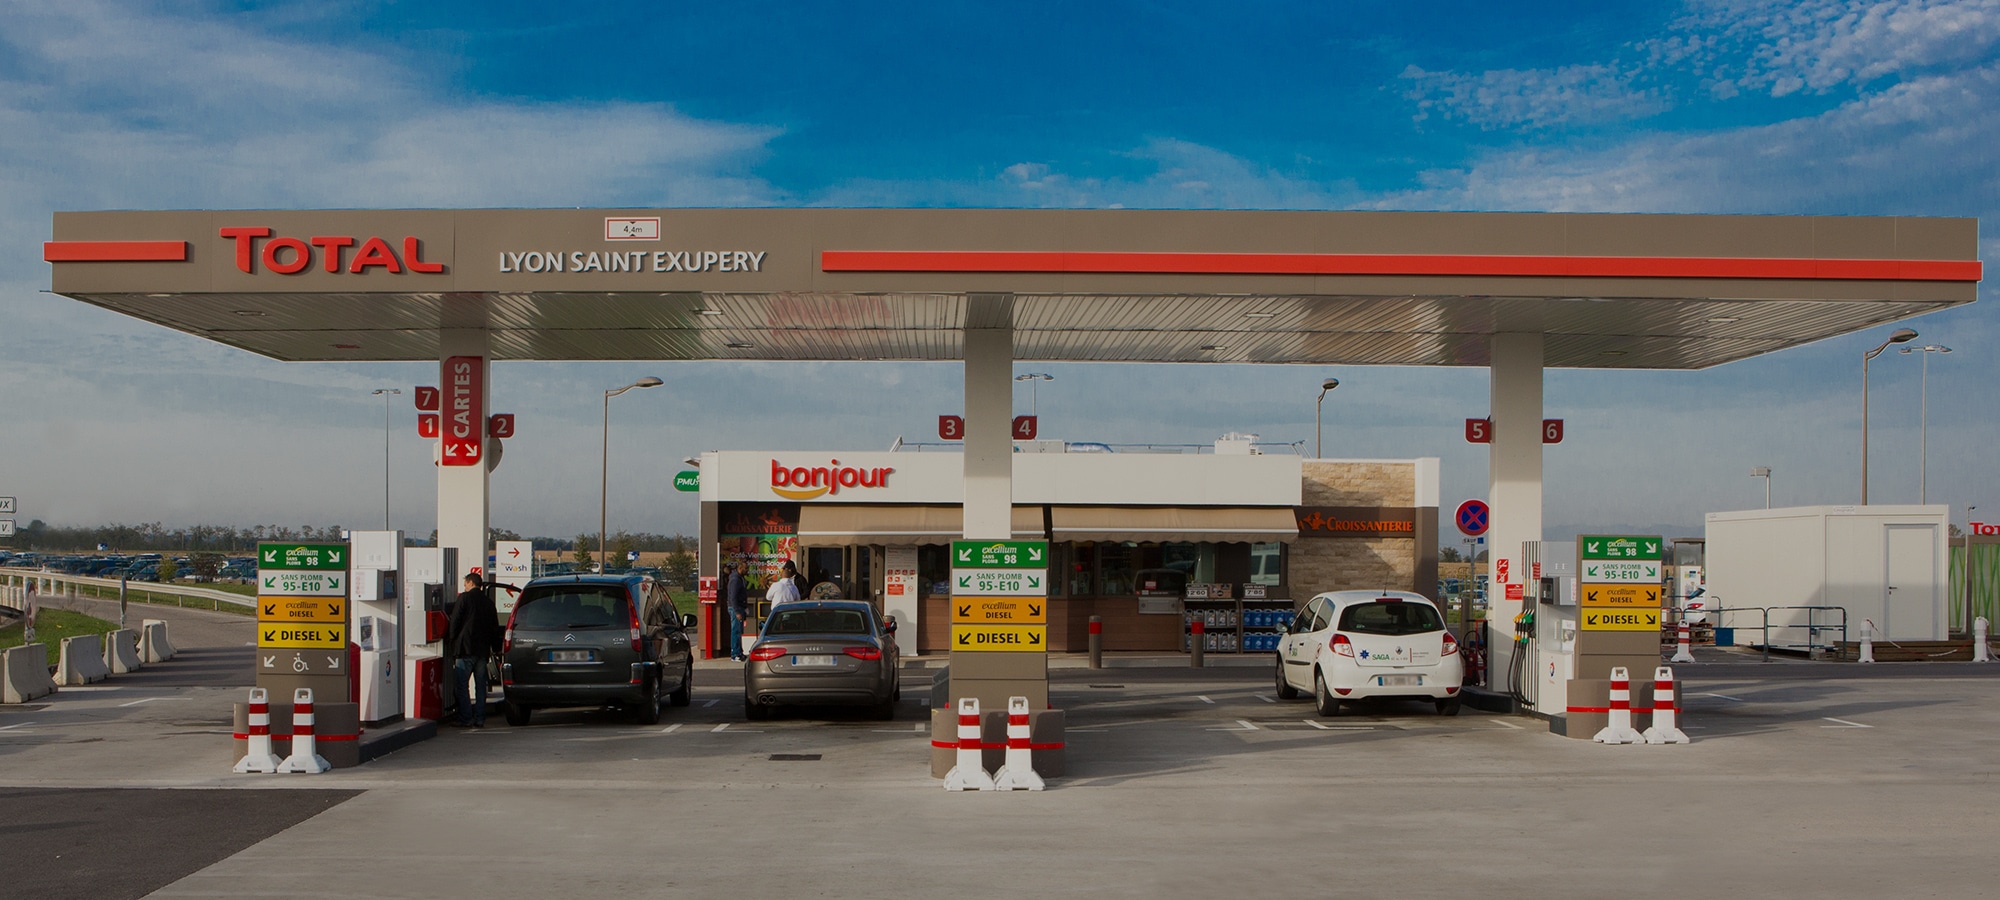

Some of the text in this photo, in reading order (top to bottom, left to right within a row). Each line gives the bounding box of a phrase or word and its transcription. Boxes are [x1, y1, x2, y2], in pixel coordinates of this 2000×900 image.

[219, 227, 443, 274] TOTAL
[500, 251, 766, 272] LYON SAINT EXUPERY
[421, 390, 432, 407] 7
[453, 362, 471, 438] CARTES
[425, 417, 433, 434] 1
[496, 418, 508, 434] 2
[945, 419, 956, 436] 3
[1018, 420, 1031, 436] 4
[1472, 423, 1484, 439] 5
[1546, 423, 1557, 439] 6
[676, 477, 695, 486] PMU
[771, 459, 893, 495] bonjour
[1326, 516, 1413, 532] CROISSANTERIE
[982, 545, 1017, 554] excellium
[1625, 548, 1637, 556] 98
[306, 557, 318, 566] 98
[1004, 555, 1017, 564] 98
[505, 564, 527, 572] wash
[1604, 571, 1639, 579] 95-E10
[283, 582, 321, 591] 95-E10
[979, 581, 1020, 591] 95-E10
[982, 601, 1017, 610] excellium
[1602, 615, 1640, 624] DIESEL
[281, 631, 322, 640] DIESEL
[977, 633, 1021, 643] DIESEL
